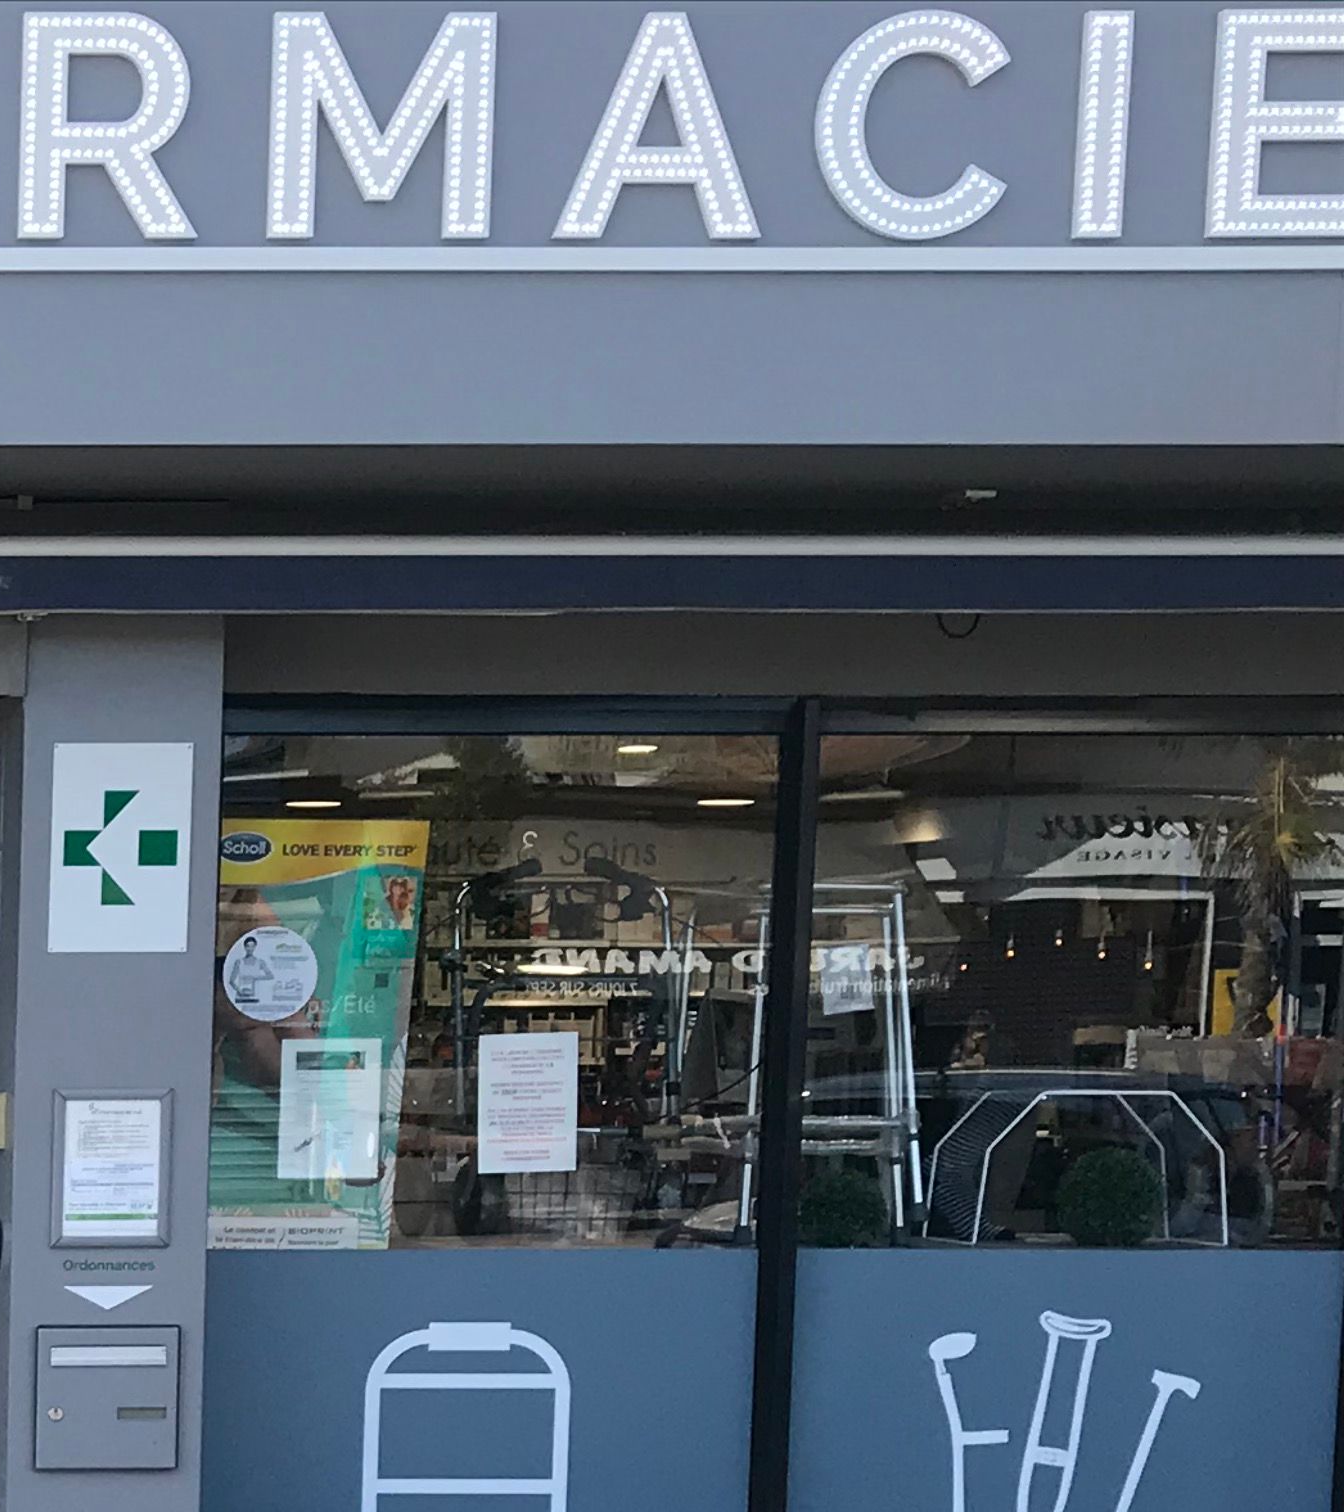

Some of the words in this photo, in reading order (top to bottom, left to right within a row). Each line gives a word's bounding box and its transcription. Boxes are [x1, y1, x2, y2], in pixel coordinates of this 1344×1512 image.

[223, 840, 267, 855] Scholl
[282, 844, 320, 857] LOVE
[324, 844, 370, 857] EVERY
[63, 1259, 156, 1272] Ordonnances
